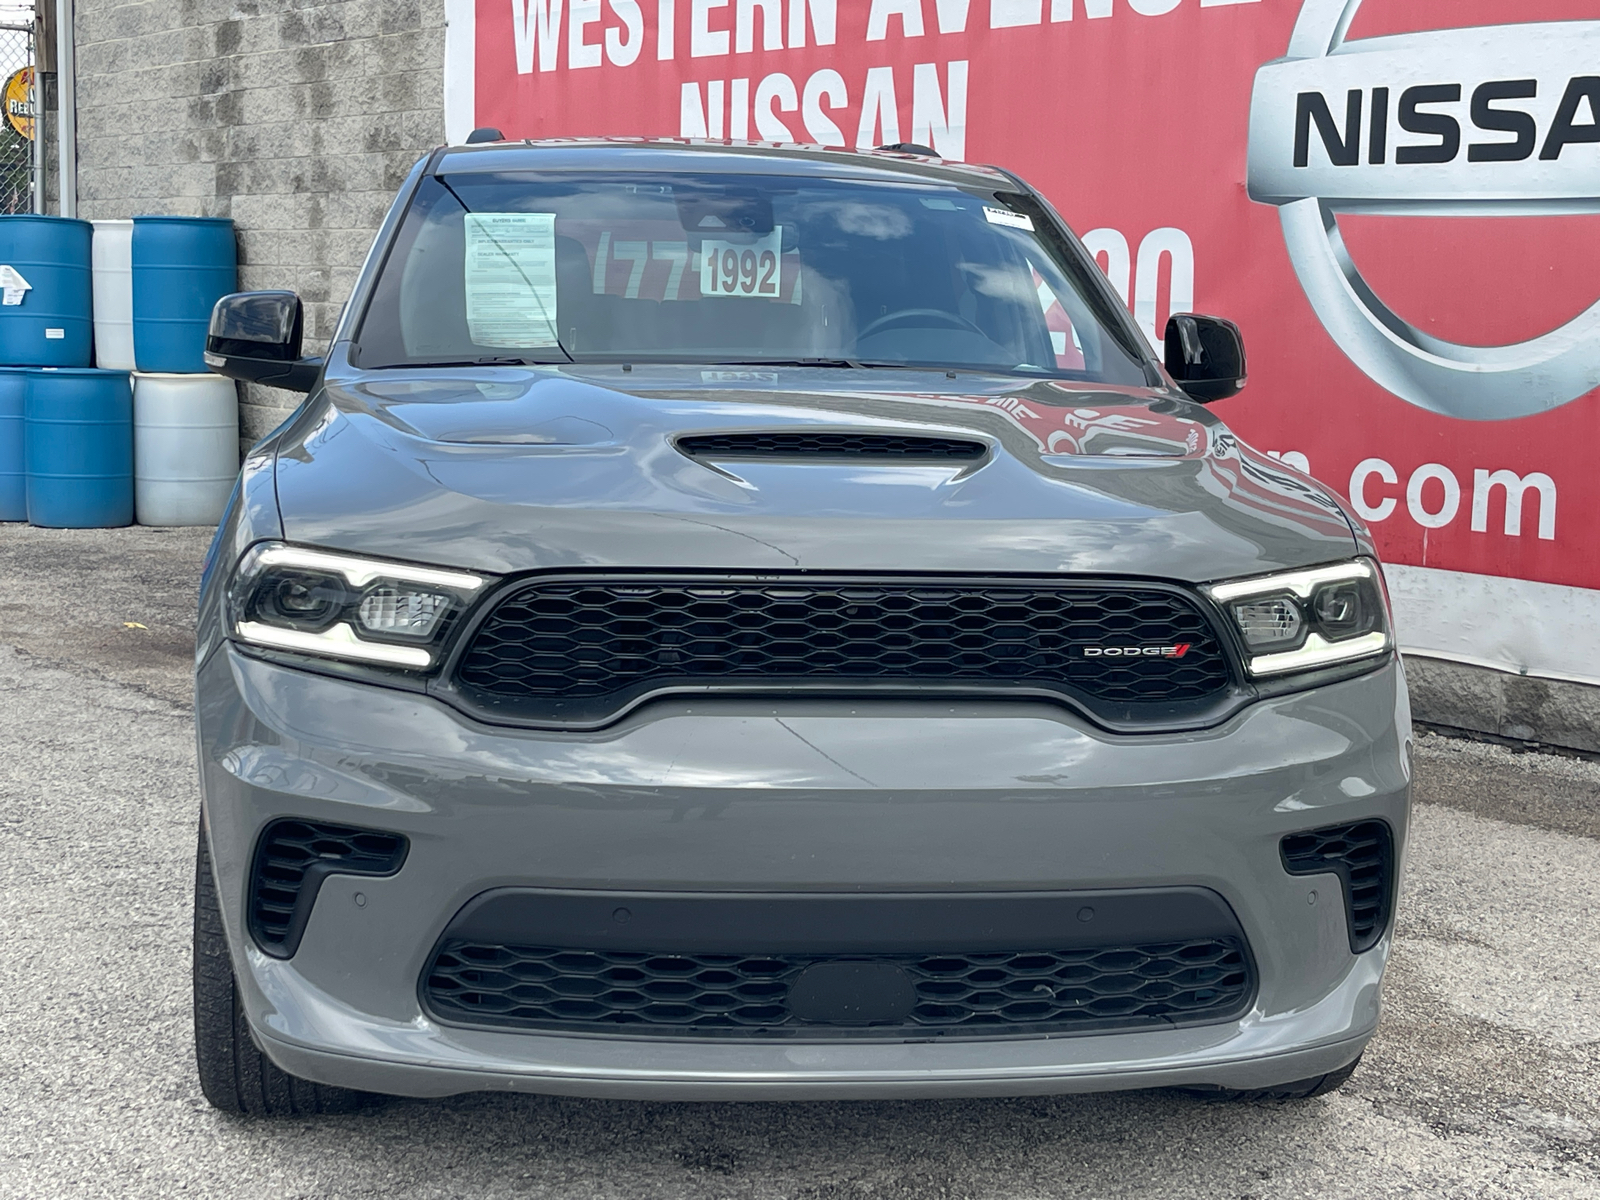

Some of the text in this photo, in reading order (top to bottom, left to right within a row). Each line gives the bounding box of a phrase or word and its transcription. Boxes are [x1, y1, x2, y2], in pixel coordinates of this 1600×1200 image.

[680, 60, 969, 163] NISSAN
[708, 248, 776, 294] 1992
[1267, 451, 1556, 540] com
[1084, 647, 1178, 657] DODGE
